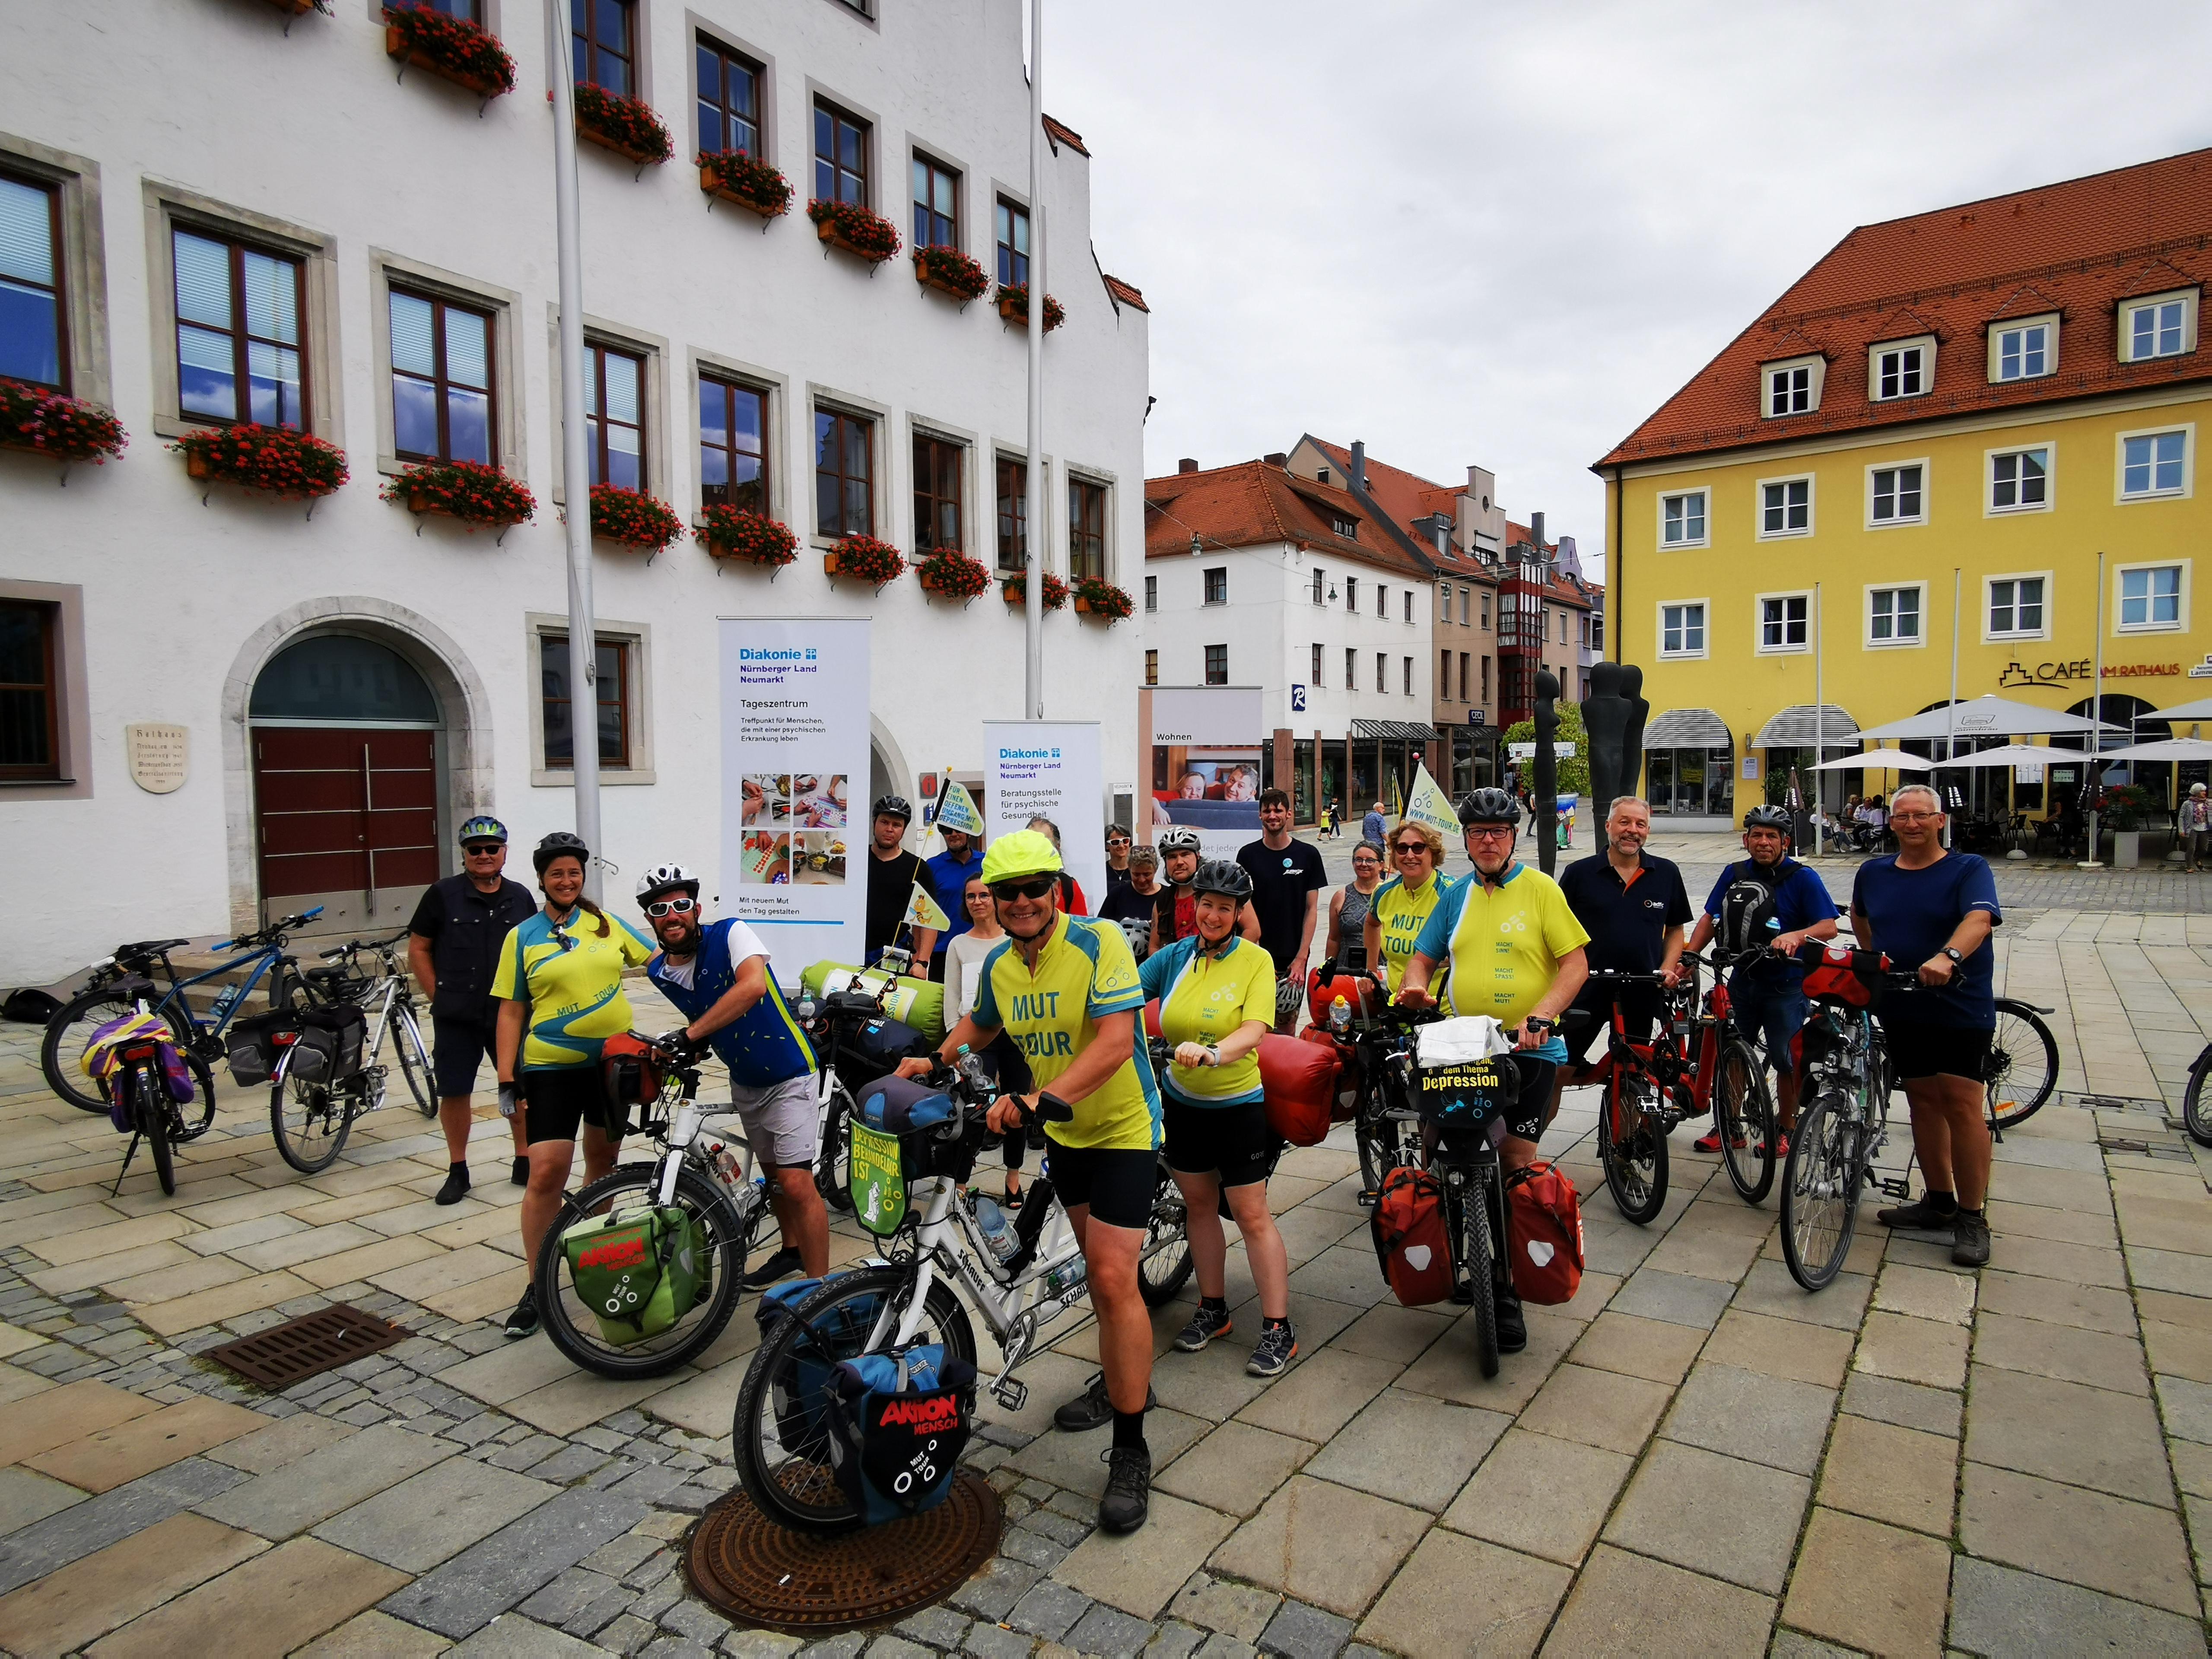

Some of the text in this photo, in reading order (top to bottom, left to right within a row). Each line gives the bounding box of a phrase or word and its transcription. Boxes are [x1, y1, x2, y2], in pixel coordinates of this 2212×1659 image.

[740, 648, 801, 660] Diakonie
[740, 665, 791, 674] Nürnberger
[2037, 658, 2091, 680] CAFÉ
[2120, 663, 2180, 676] RATHAUS
[741, 699, 808, 709] Tageszentrum
[1294, 687, 1306, 707] R
[1000, 748, 1049, 758] Diakonie
[949, 785, 961, 794] FÜR
[1001, 788, 1062, 798] Beratungsstelle
[946, 793, 963, 803] EINEN
[1014, 800, 1058, 810] psychische
[944, 800, 969, 813] OFFENEN
[939, 814, 973, 830] DEPRESSION
[941, 807, 976, 824] UMGANG MIT
[1001, 810, 1047, 820] Gesundheit
[1409, 808, 1460, 834] WWW.MUT-TOUR.DE
[1215, 844, 1238, 854] jeder
[754, 907, 766, 915] Tag
[1391, 913, 1424, 932] MUT
[556, 983, 615, 1017] MUT TOUR
[1012, 991, 1059, 1022] MUT
[1199, 1030, 1216, 1039] MACHT
[1012, 1031, 1074, 1057] TOUR
[1443, 1066, 1461, 1074] dem
[1462, 1065, 1489, 1074] Thema
[1422, 1074, 1498, 1091] Depression
[853, 1125, 899, 1160] DEPRESSION
[853, 1143, 899, 1177] BEHANDELBAR
[854, 1160, 870, 1181] IST
[957, 1249, 986, 1293] SCHAUFF
[612, 1283, 621, 1295] MUT
[617, 1286, 628, 1299] TOUR
[914, 1417, 958, 1436] MENSCH
[909, 1451, 925, 1467] MUT
[913, 1456, 930, 1475] TOUR
